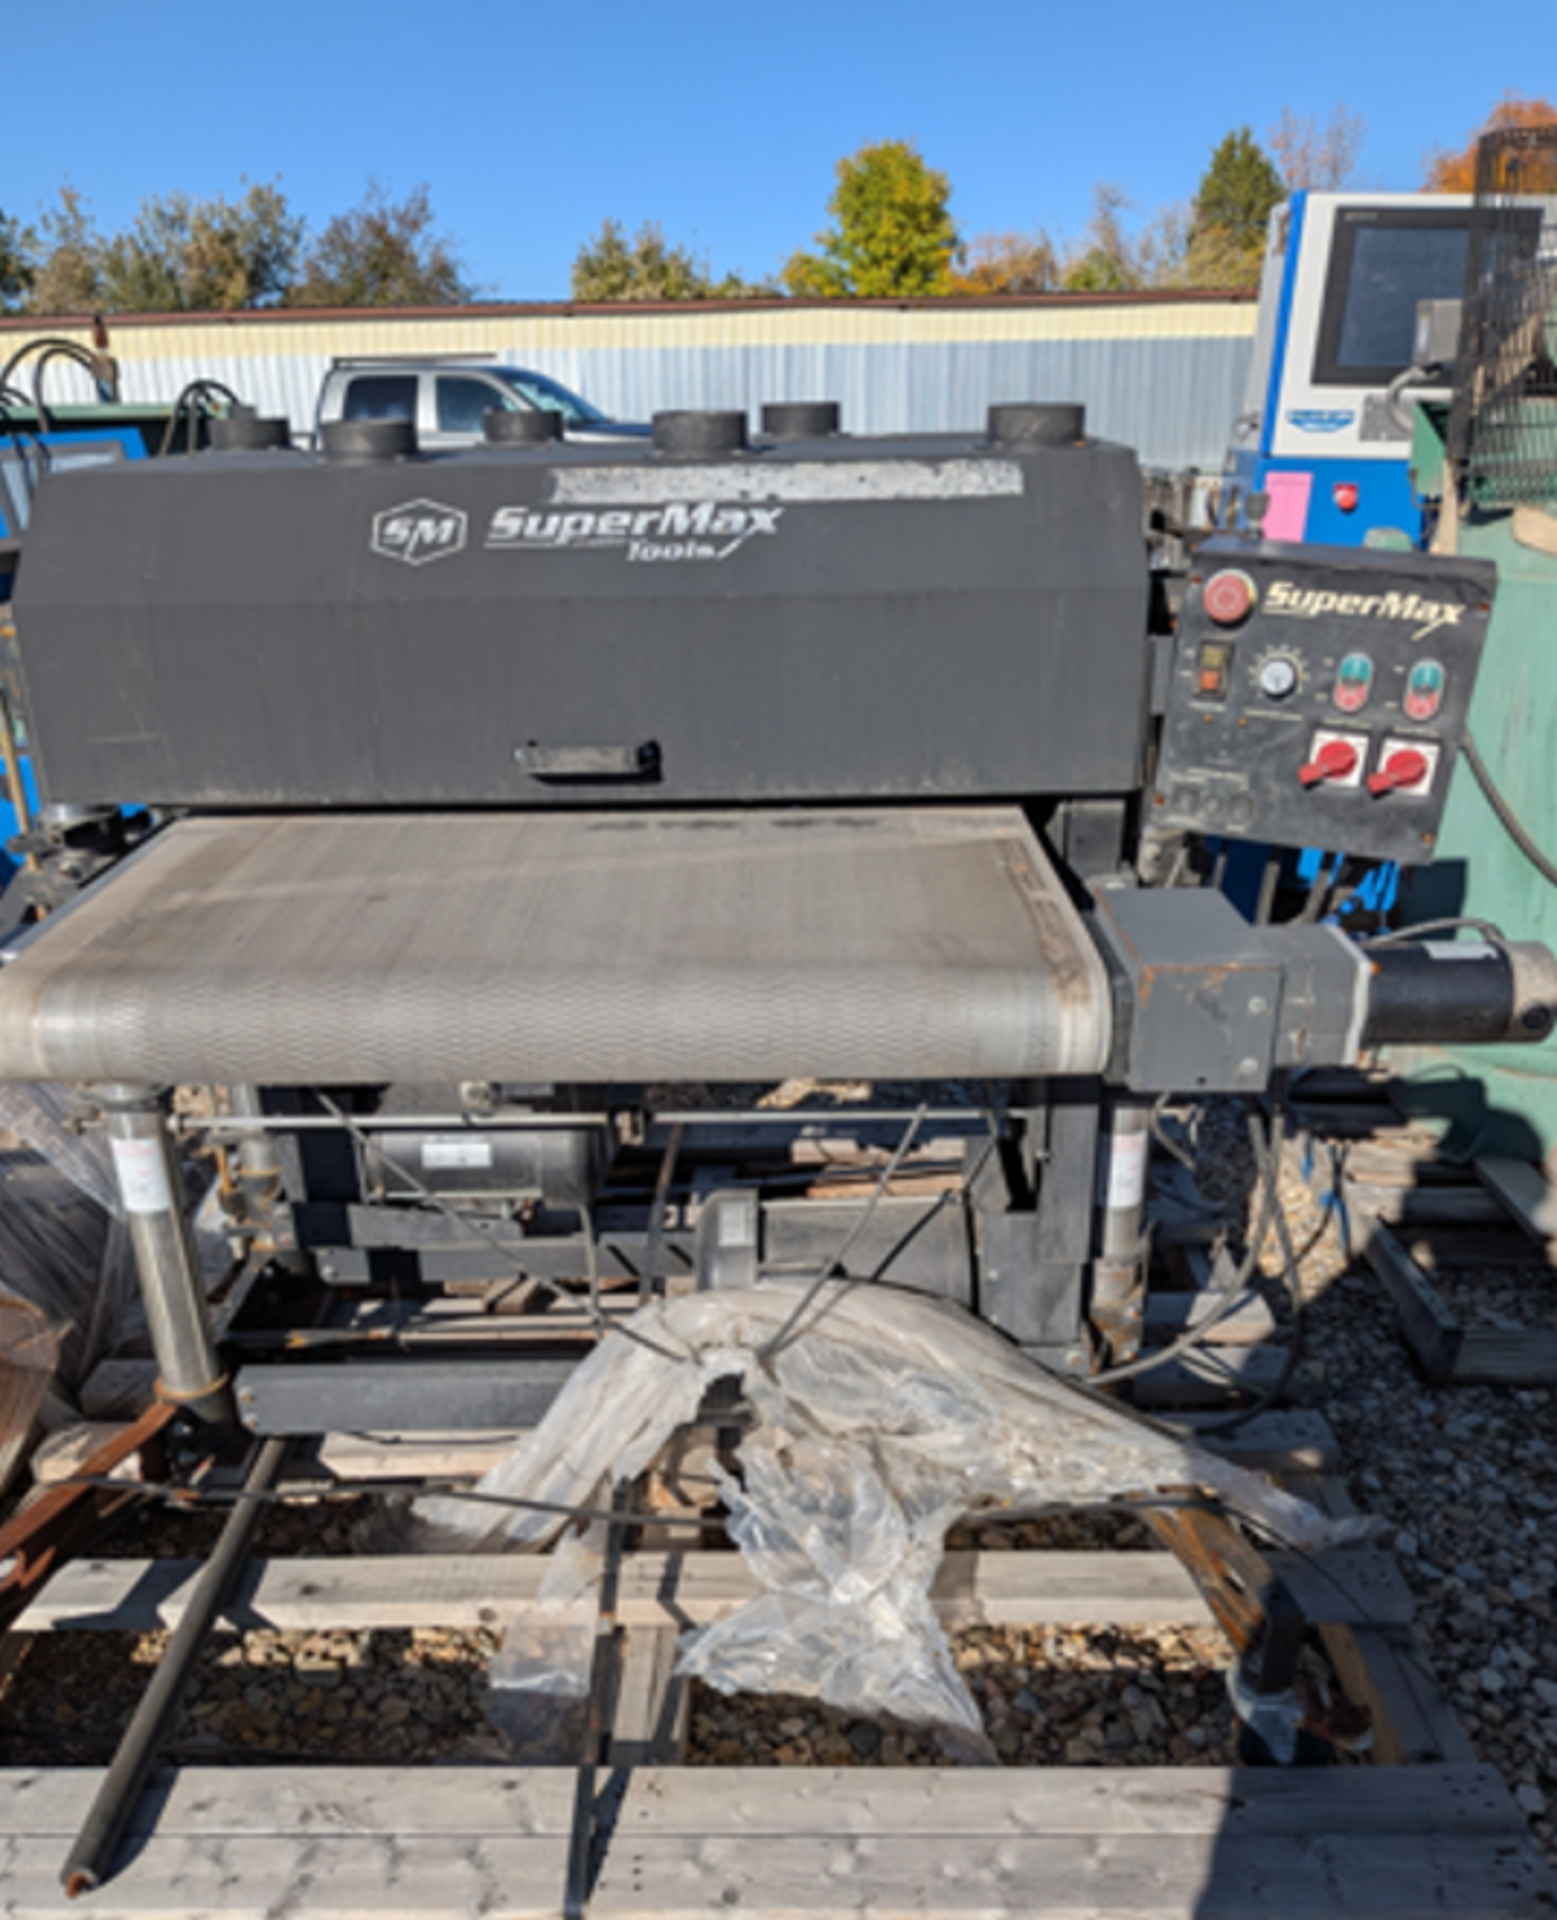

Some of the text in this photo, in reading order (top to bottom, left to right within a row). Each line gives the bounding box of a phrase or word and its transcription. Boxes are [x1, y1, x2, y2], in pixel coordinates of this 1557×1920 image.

[382, 516, 457, 552] SM
[485, 503, 784, 549] SuperMax
[626, 539, 715, 562] Tools
[1262, 579, 1466, 636] SuperMax
